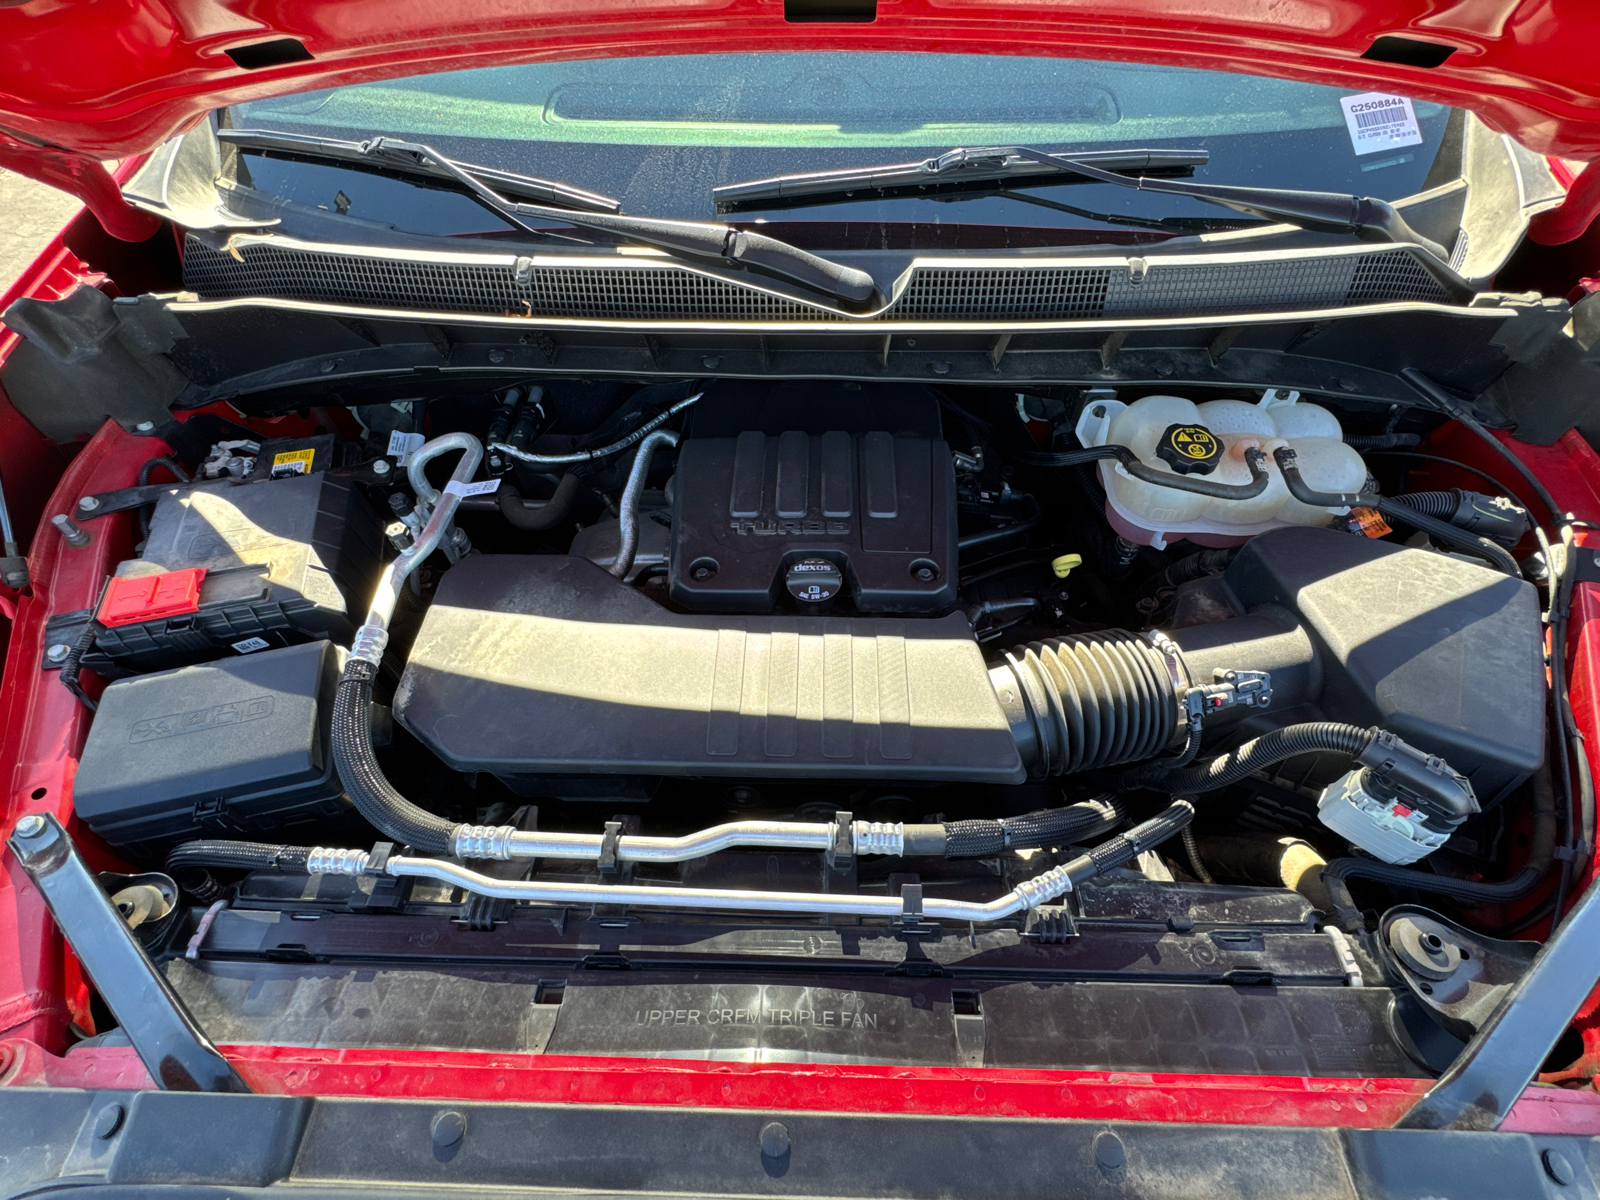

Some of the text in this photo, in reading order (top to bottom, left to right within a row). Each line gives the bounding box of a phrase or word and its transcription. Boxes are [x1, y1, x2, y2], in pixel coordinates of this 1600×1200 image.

[730, 521, 850, 535] TURBO
[794, 564, 831, 572] dexos
[636, 1008, 878, 1030] UPPER CRFM TRIPLE FAN
